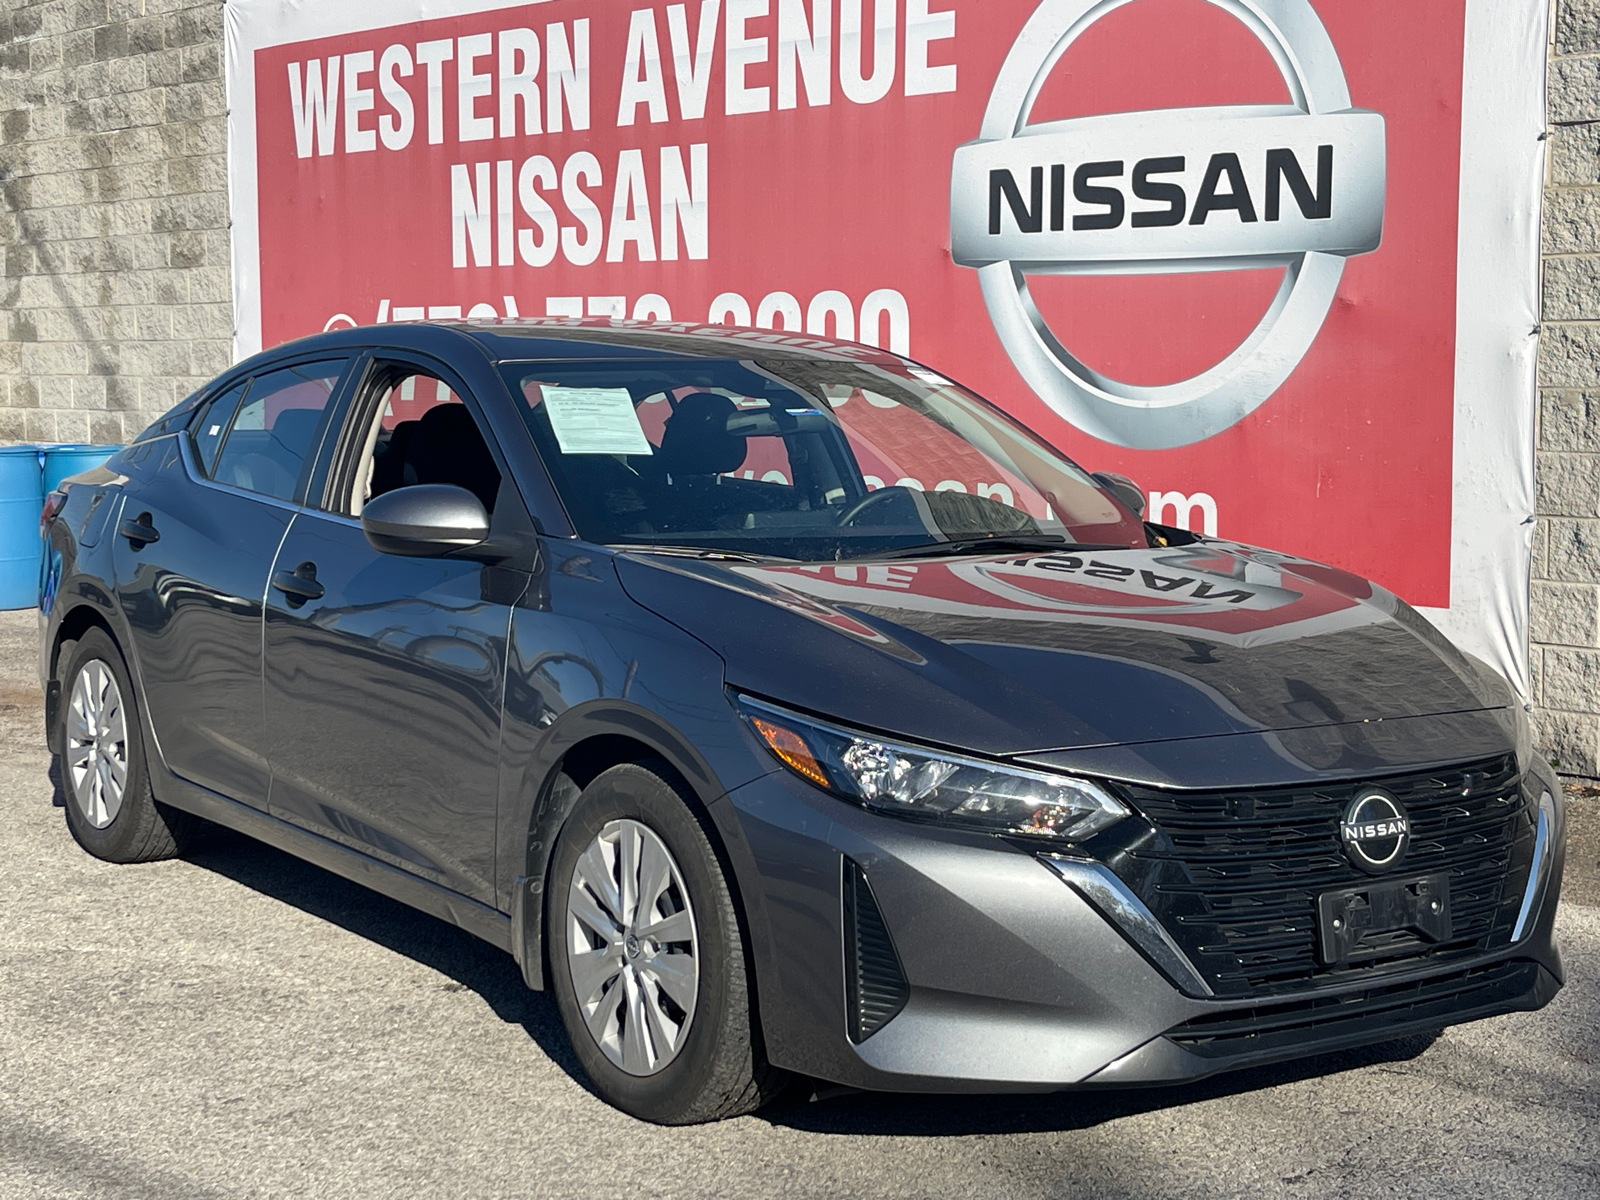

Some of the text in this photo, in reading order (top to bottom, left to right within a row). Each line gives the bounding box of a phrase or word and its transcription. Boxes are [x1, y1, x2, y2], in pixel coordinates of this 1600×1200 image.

[288, 0, 958, 159] WESTERN AVENUE
[451, 143, 709, 268] NISSAN
[988, 144, 1334, 236] NISSAN
[1345, 819, 1407, 840] NISSAN
